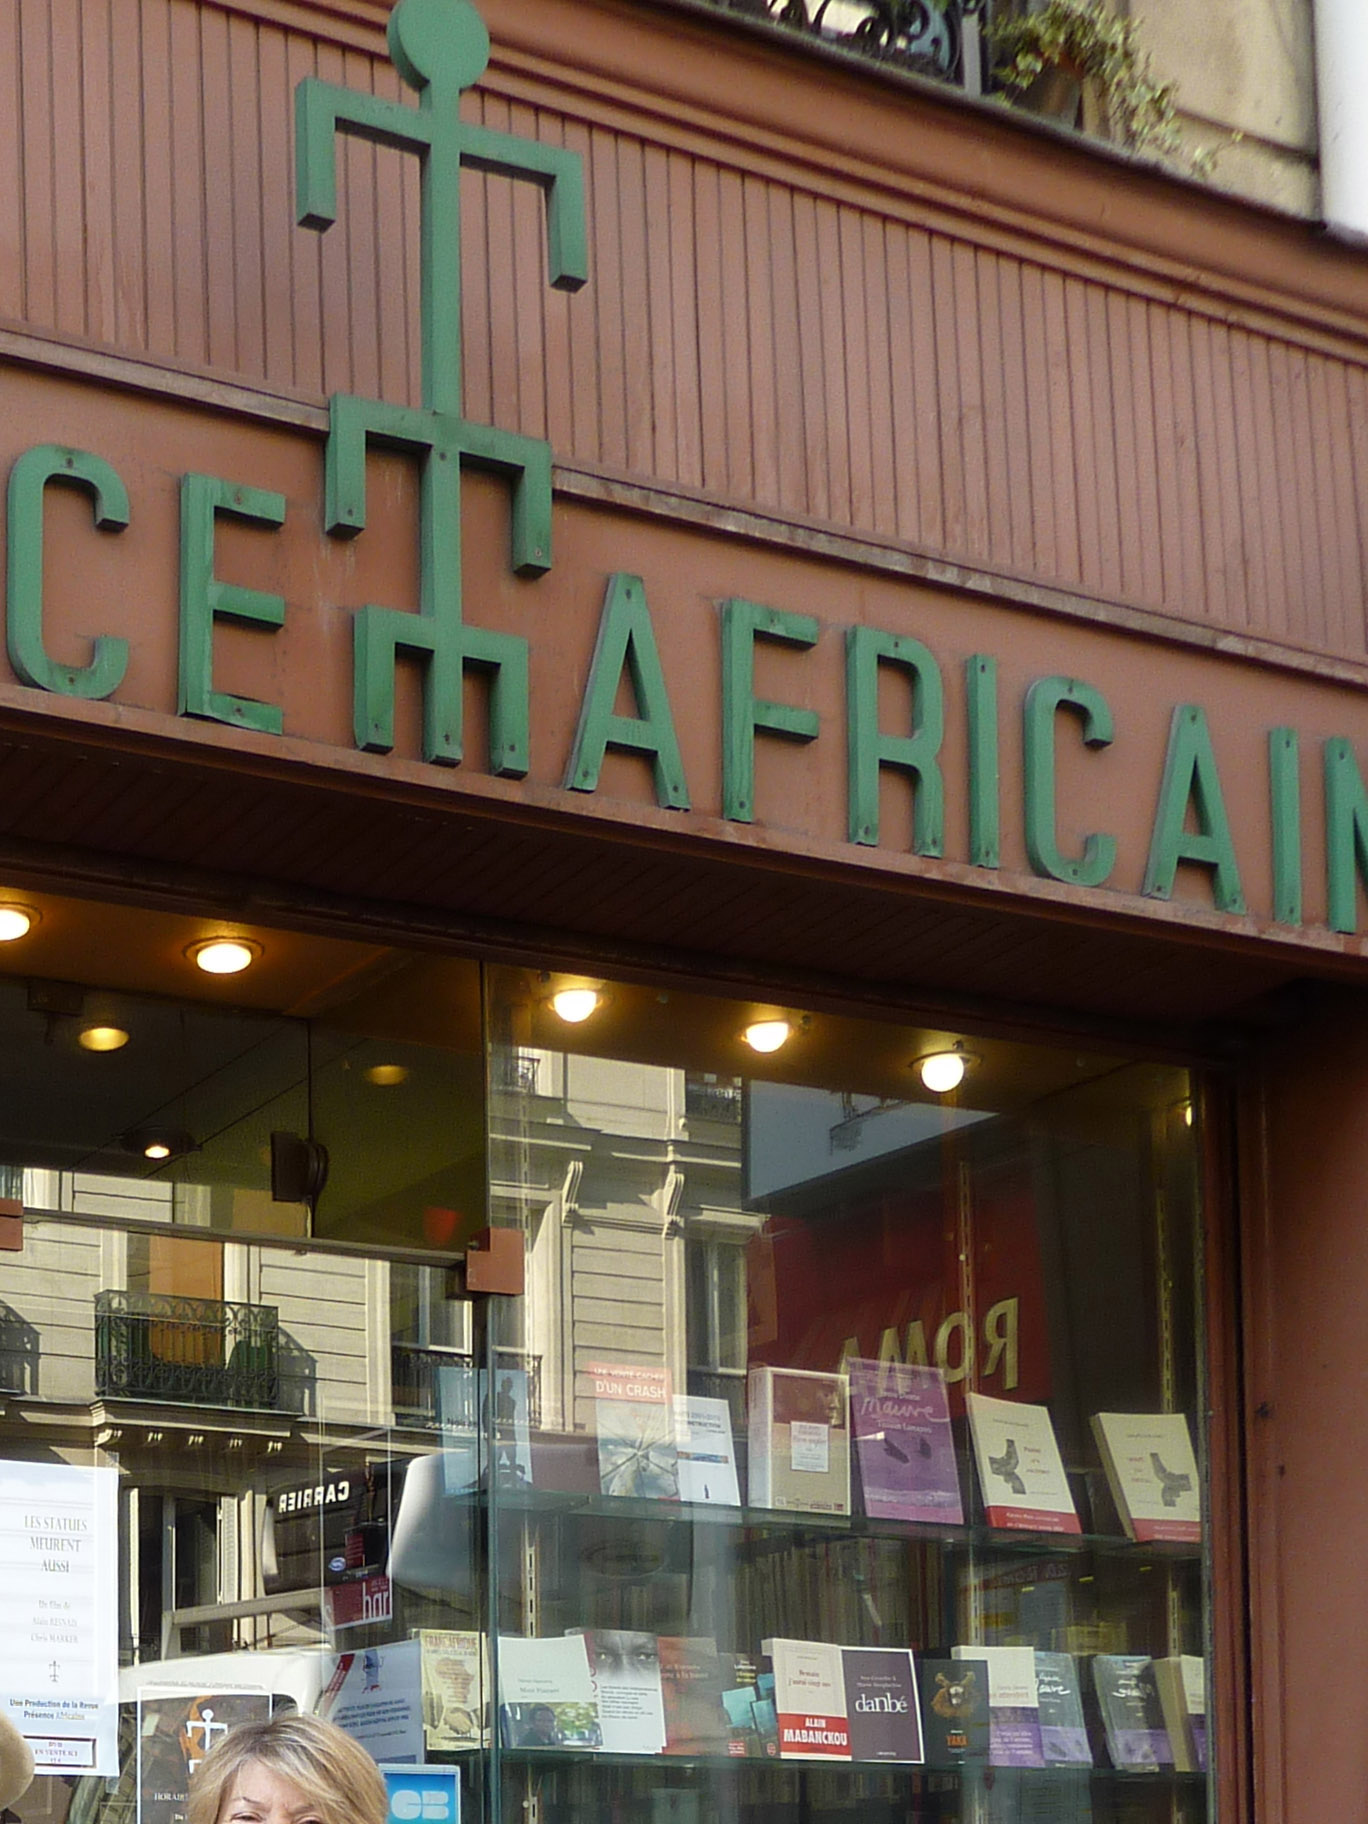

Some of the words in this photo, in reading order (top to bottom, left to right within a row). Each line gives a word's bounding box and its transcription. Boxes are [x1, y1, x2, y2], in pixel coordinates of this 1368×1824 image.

[595, 1379, 622, 1395] D'UN
[625, 1384, 666, 1399] CRASH
[24, 1514, 41, 1529] LES
[43, 1516, 88, 1532] STATUES
[30, 1536, 82, 1553] MEURENT
[40, 1560, 70, 1574] AUSSI
[9, 1698, 23, 1708] Une
[24, 1699, 61, 1709] Production
[62, 1700, 70, 1709] de
[71, 1700, 78, 1709] la
[855, 1692, 908, 1713] danbé
[23, 1710, 55, 1720] Présence
[805, 1717, 827, 1729] ALAIN
[783, 1728, 848, 1746] MABANCKOU
[390, 1789, 450, 1820] CB
